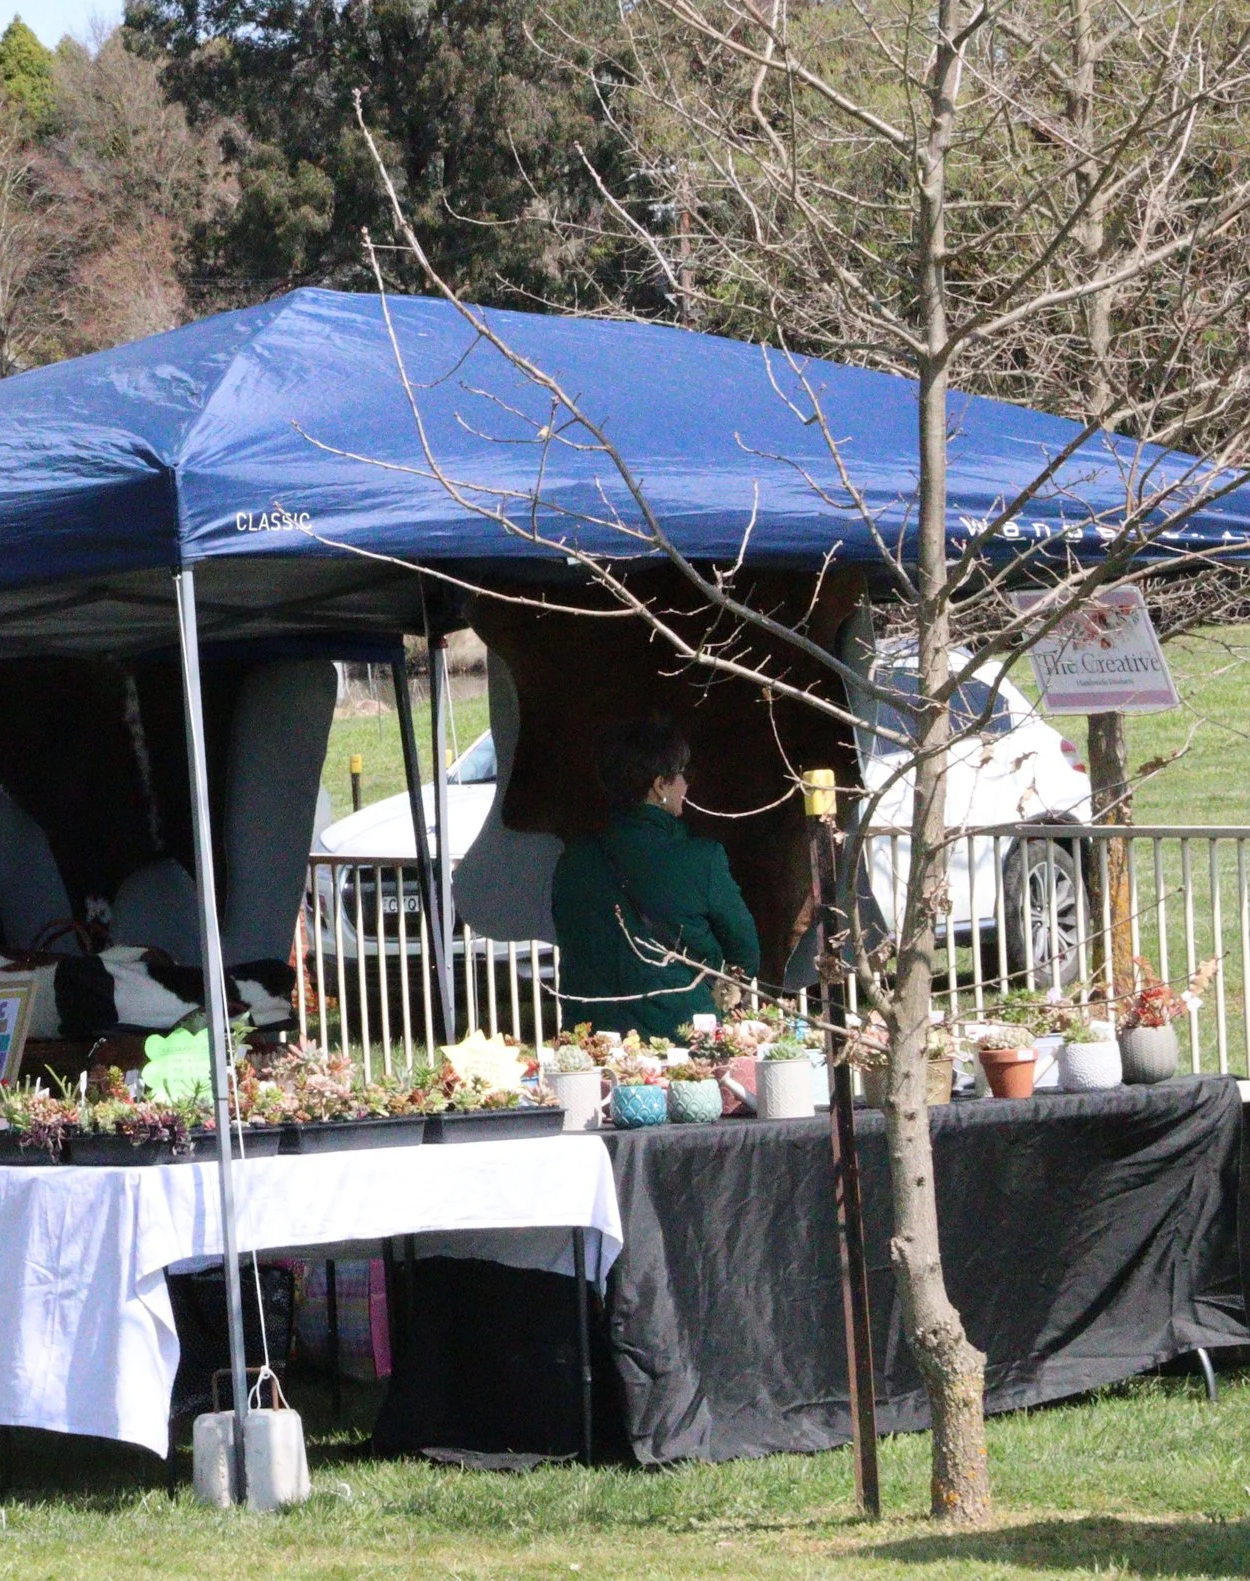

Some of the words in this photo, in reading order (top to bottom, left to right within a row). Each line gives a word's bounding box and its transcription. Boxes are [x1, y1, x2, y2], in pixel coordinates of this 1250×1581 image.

[235, 512, 312, 531] CLASSIC
[1037, 651, 1077, 675] The
[1081, 652, 1162, 675] Creative
